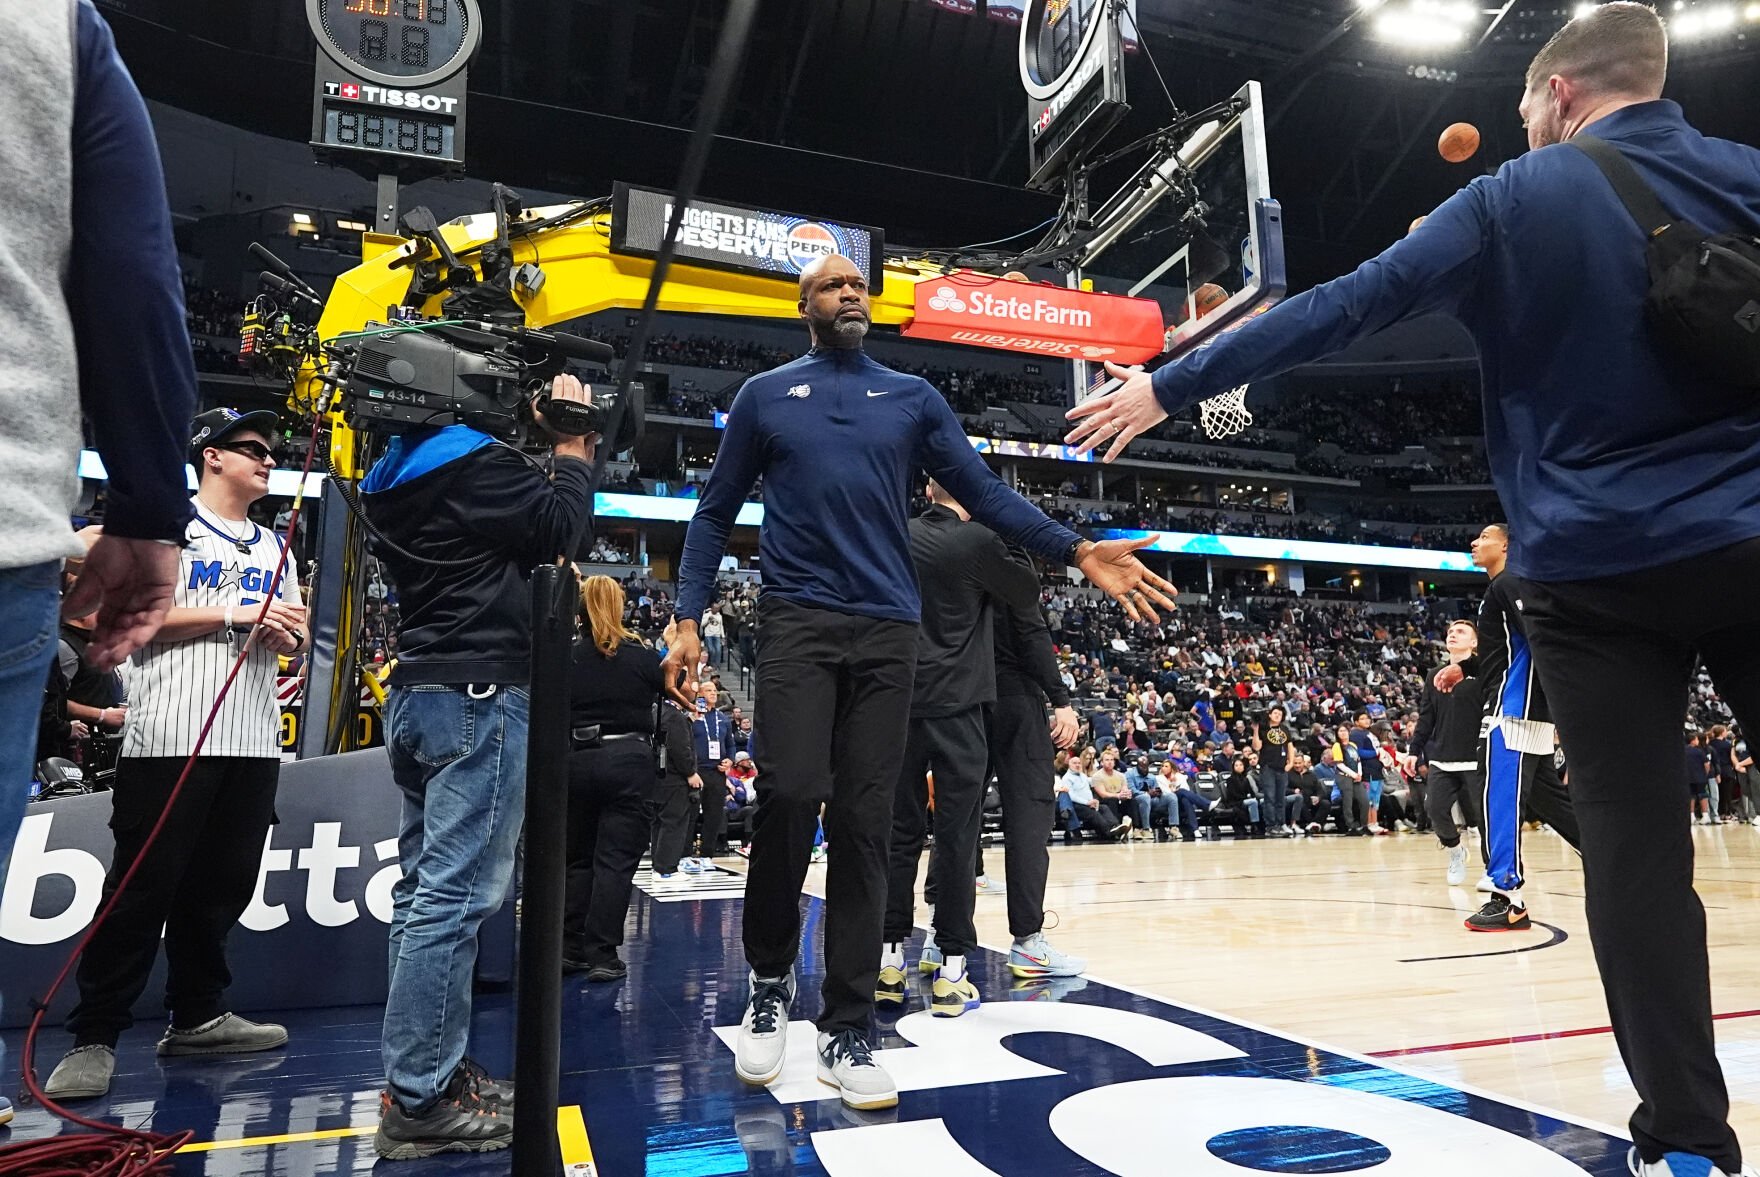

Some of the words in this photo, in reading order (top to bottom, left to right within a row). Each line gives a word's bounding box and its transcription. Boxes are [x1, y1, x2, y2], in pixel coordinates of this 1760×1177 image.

[1050, 45, 1104, 117] TISSOT
[362, 86, 458, 113] TISSOT
[746, 217, 788, 242] FANS
[791, 240, 836, 256] PEPSI
[386, 390, 426, 405] 43-14
[0, 812, 403, 945] btt
